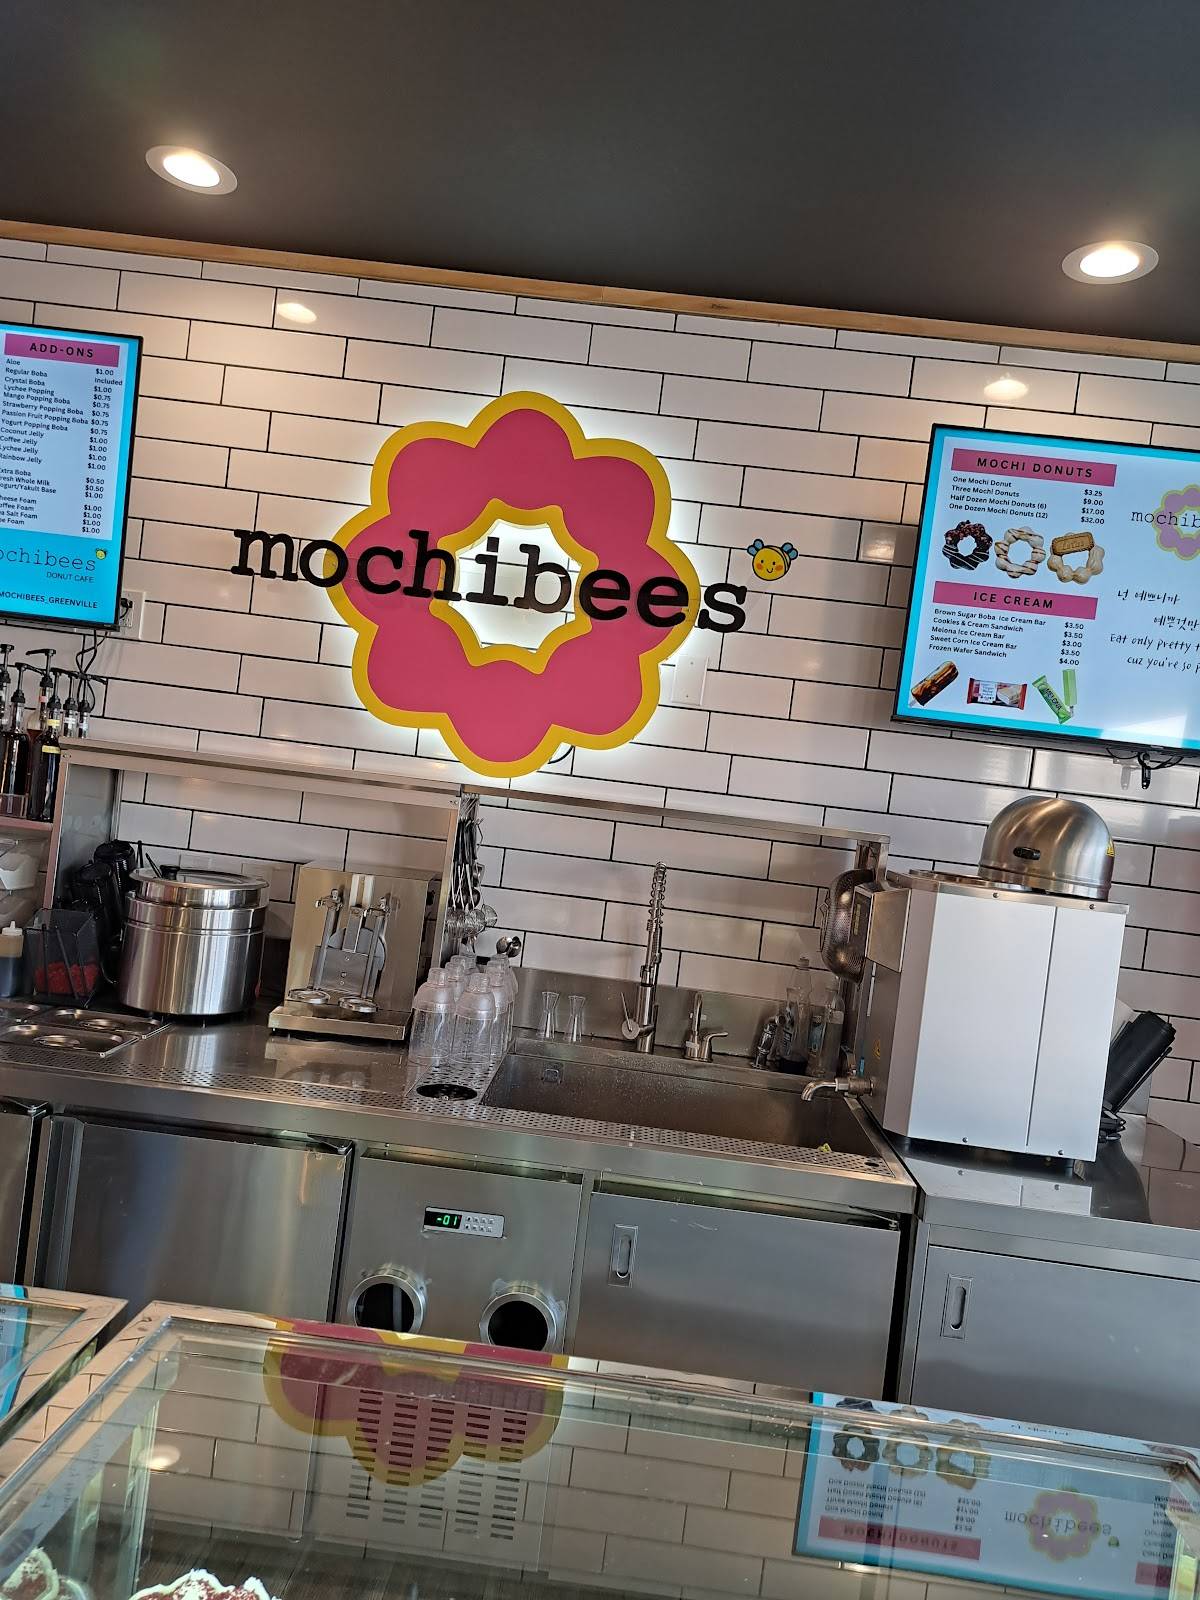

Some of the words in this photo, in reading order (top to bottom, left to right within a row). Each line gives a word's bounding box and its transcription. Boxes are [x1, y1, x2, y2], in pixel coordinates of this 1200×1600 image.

[30, 343, 94, 358] ADD-ONS
[6, 368, 30, 376] Regular
[4, 376, 27, 384] Crystal
[4, 392, 24, 400] Mango
[26, 395, 52, 404] Popping
[28, 388, 54, 396] Popping
[2, 401, 38, 410] Strawberry
[40, 406, 66, 414] Popping
[2, 419, 22, 427] Yogurt
[24, 420, 50, 430] Popping
[44, 414, 70, 424] Popping
[0, 427, 27, 436] Coconut
[28, 430, 44, 438] Jelly
[22, 438, 38, 446] Jelly
[26, 456, 42, 464] Jelly
[88, 462, 106, 470] $1.00
[88, 454, 106, 462] $1.00
[977, 458, 1026, 470] MOCHI
[1032, 464, 1092, 478] DONUTS
[0, 484, 40, 492] ogurt/Yakult
[968, 477, 988, 485] Mochi
[990, 480, 1012, 488] Donut
[1084, 489, 1102, 497] $3.25
[995, 490, 1020, 498] Donuts
[1083, 498, 1103, 506] $9.00
[1011, 500, 1036, 508] Donuts
[1082, 507, 1104, 516] $17.00
[1080, 516, 1104, 524] $32.00
[46, 571, 72, 580] DONUT
[74, 574, 94, 583] CAFE
[230, 529, 748, 634] mochibees
[974, 592, 996, 602] ICE
[1004, 596, 1053, 608] CREAM
[1118, 589, 1128, 600] 넌
[958, 611, 976, 620] Sugar
[1010, 616, 1032, 624] Cream
[932, 626, 956, 635] Melona
[933, 618, 960, 626] Cookies
[968, 621, 989, 629] Cream
[990, 624, 1024, 632] Sandwich
[1064, 631, 1083, 639] $3.50
[982, 640, 1004, 648] Cream
[1060, 648, 1080, 656] $3.50
[1110, 633, 1128, 644] Eat
[1132, 635, 1154, 650] only
[1156, 639, 1191, 654] pretty
[929, 644, 952, 652] Frozen
[954, 646, 973, 654] Wafer
[974, 648, 1006, 658] Sandwich
[1059, 658, 1080, 666] $4.00
[1127, 656, 1142, 665] cuz
[1147, 657, 1178, 670] you're
[1182, 663, 1192, 672] so
